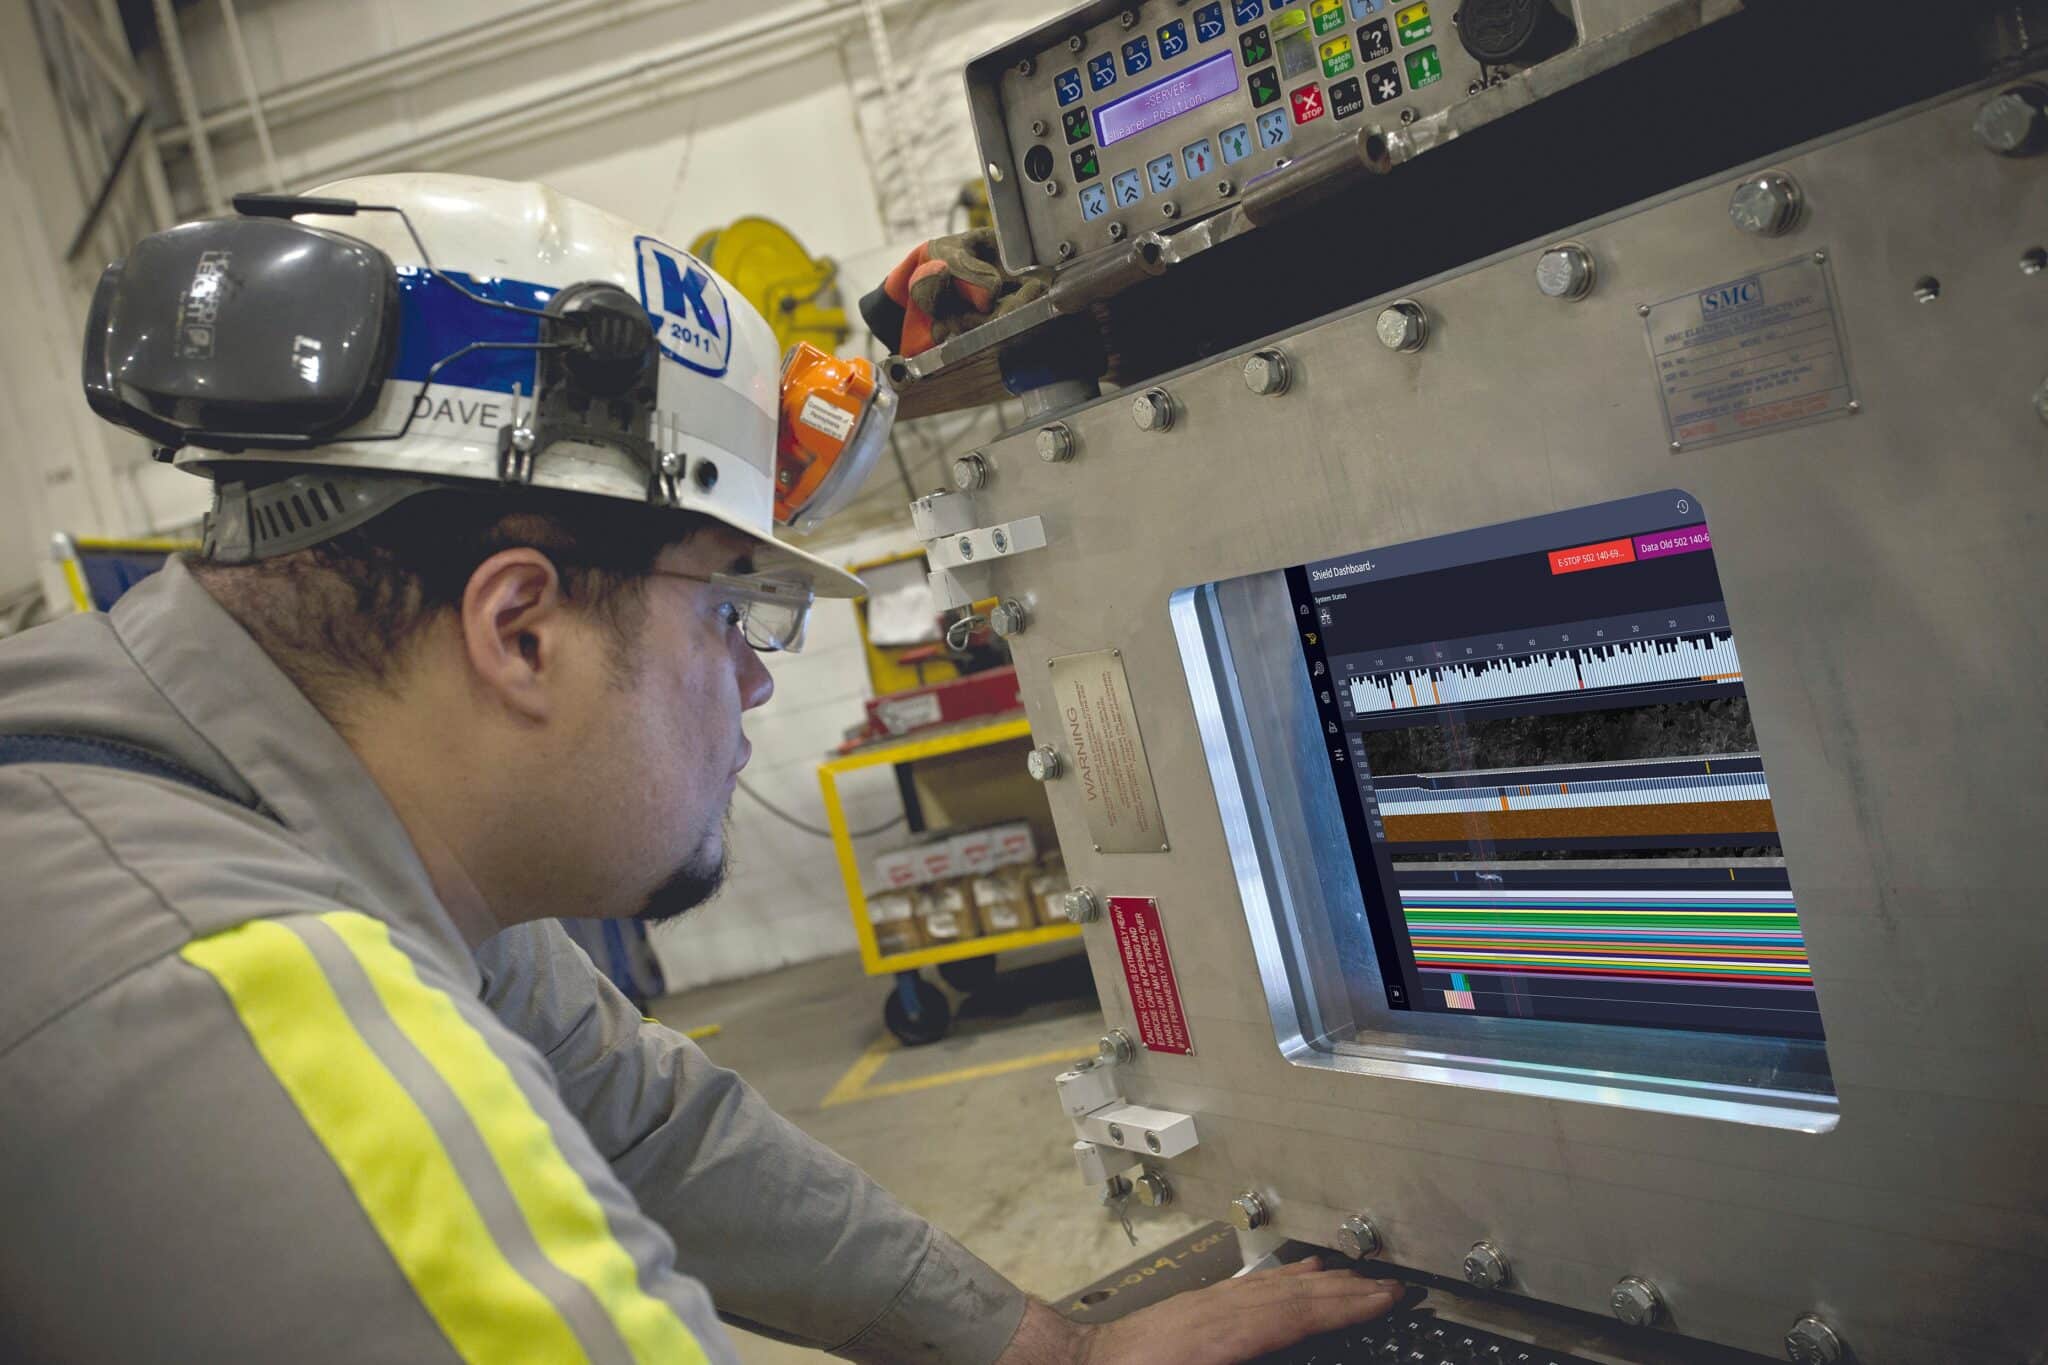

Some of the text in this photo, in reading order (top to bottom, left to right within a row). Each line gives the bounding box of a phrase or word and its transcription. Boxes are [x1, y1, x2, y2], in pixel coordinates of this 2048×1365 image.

[1322, 12, 1338, 22] Pull
[1322, 18, 1341, 32] Back
[1328, 54, 1350, 66] Batch
[1370, 46, 1389, 60] Help
[1418, 73, 1440, 88] START
[1302, 106, 1322, 122] STOP
[1336, 99, 1362, 116] Enter
[652, 250, 720, 340] K
[1704, 281, 1757, 310] SMC
[671, 323, 711, 353] 2011
[413, 395, 500, 428] DAVE
[1642, 542, 1659, 553] Data
[1660, 538, 1673, 550] Old
[1674, 536, 1688, 548] 502
[1582, 554, 1594, 564] 502
[1312, 560, 1371, 581] Shield Dashboard
[1315, 595, 1331, 605] System
[1066, 707, 1097, 801] WARNING
[1112, 904, 1126, 928] HEAVY
[1134, 913, 1147, 933] OVER
[1128, 927, 1139, 942] AND
[1119, 930, 1138, 973] EXTREMELY
[1139, 934, 1154, 960] TIPPED
[1132, 944, 1148, 977] OPENING
[1149, 974, 1161, 989] MAY
[1132, 982, 1147, 1008] COVER
[1143, 987, 1156, 1008] CARE
[1153, 989, 1166, 1008] UNIT
[1158, 969, 1179, 1023] PERMANENTLY
[1158, 1009, 1175, 1046] HANDLING
[1172, 1023, 1183, 1040] NOT
